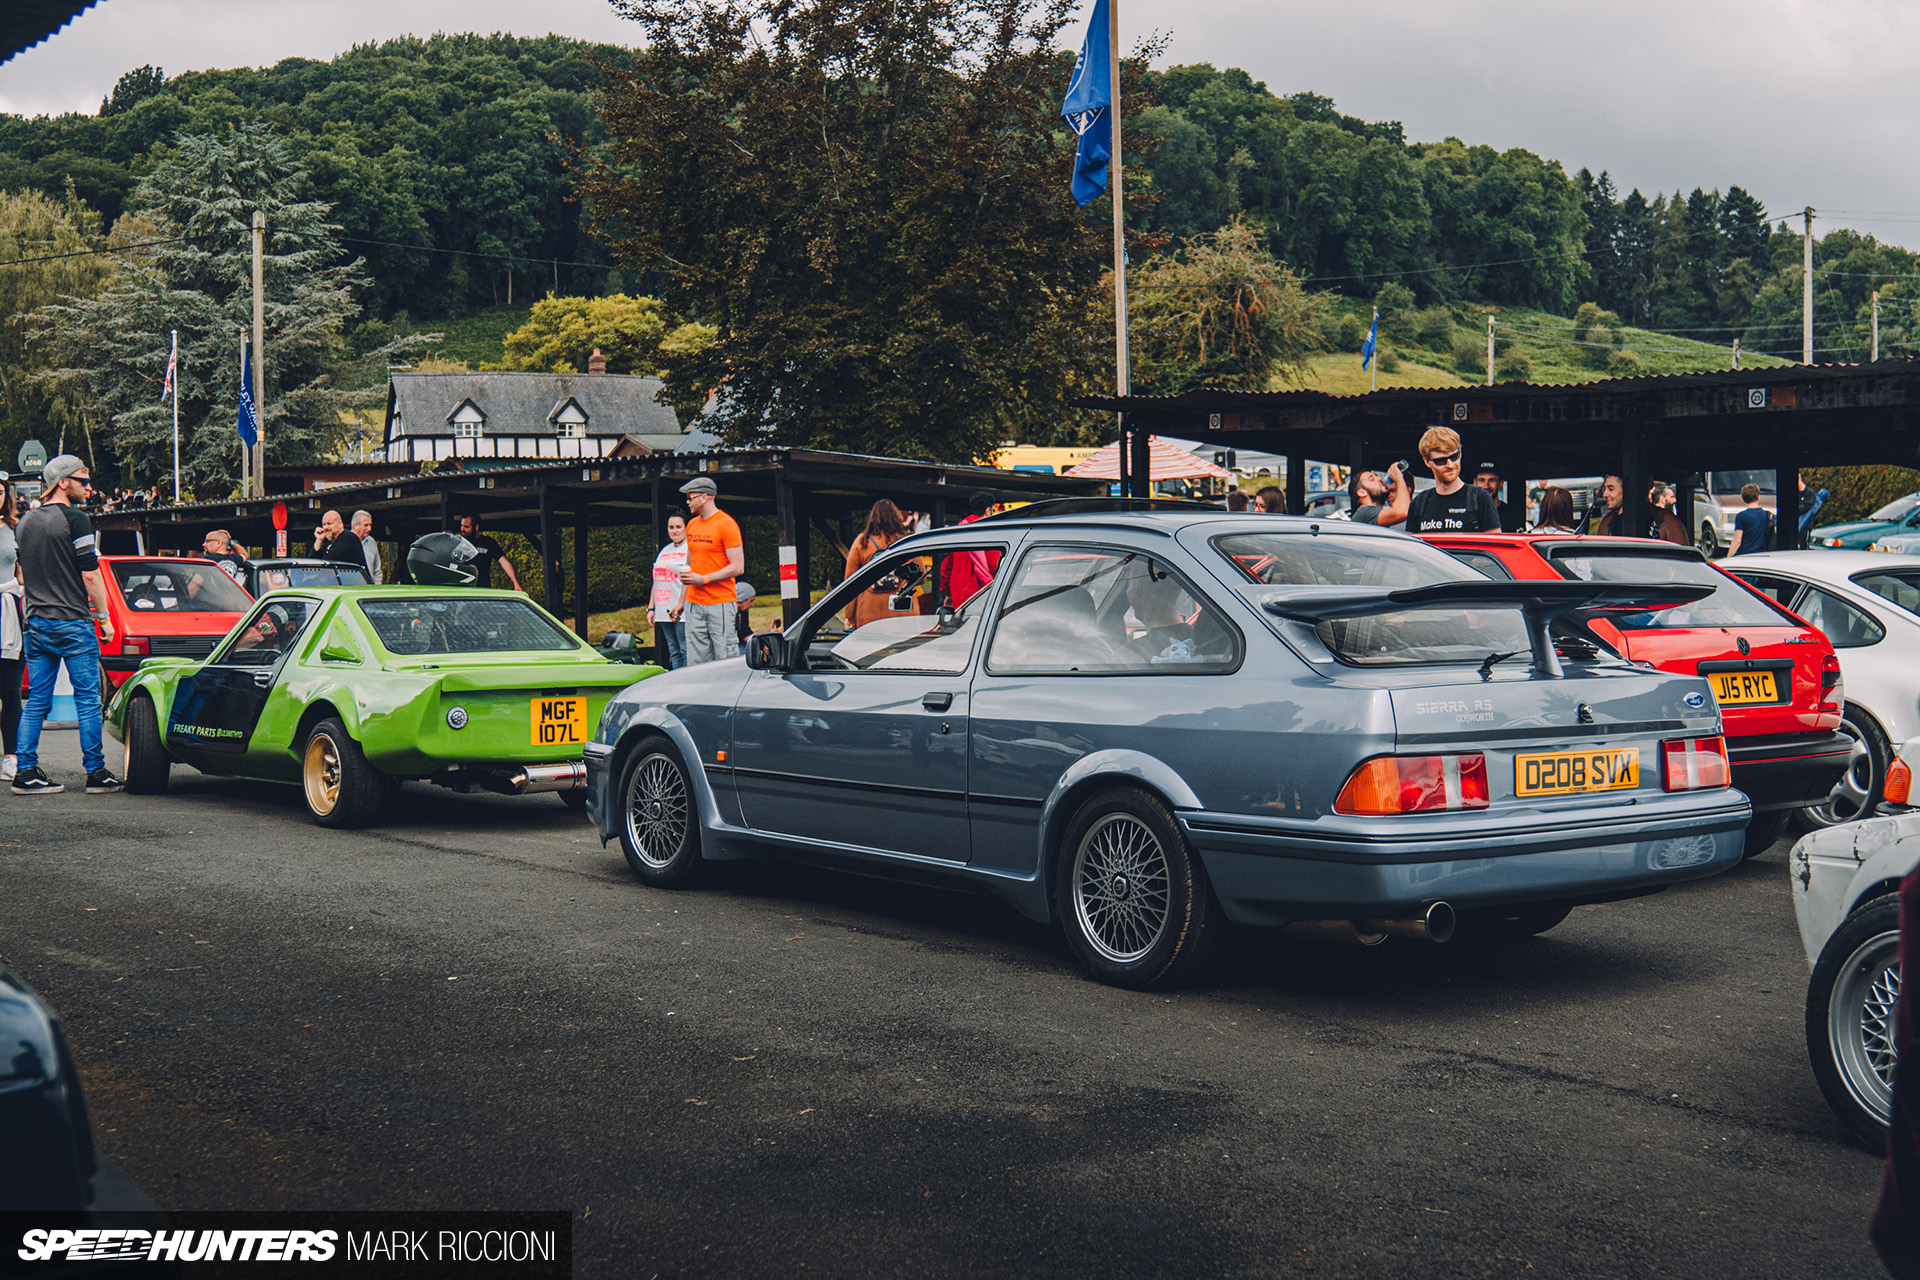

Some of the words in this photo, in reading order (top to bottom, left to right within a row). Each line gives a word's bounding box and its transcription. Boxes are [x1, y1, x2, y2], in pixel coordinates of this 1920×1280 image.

[1420, 519, 1443, 532] Make
[1444, 518, 1464, 530] The
[1741, 675, 1772, 698] RYC
[541, 700, 577, 721] MGF
[1473, 699, 1493, 711] RS
[1455, 712, 1495, 723] COSWORTH
[173, 723, 196, 735] FREAKY
[195, 725, 217, 738] PARTS
[538, 723, 580, 744] 107L
[1525, 757, 1586, 790] D208
[1591, 753, 1632, 785] SVX
